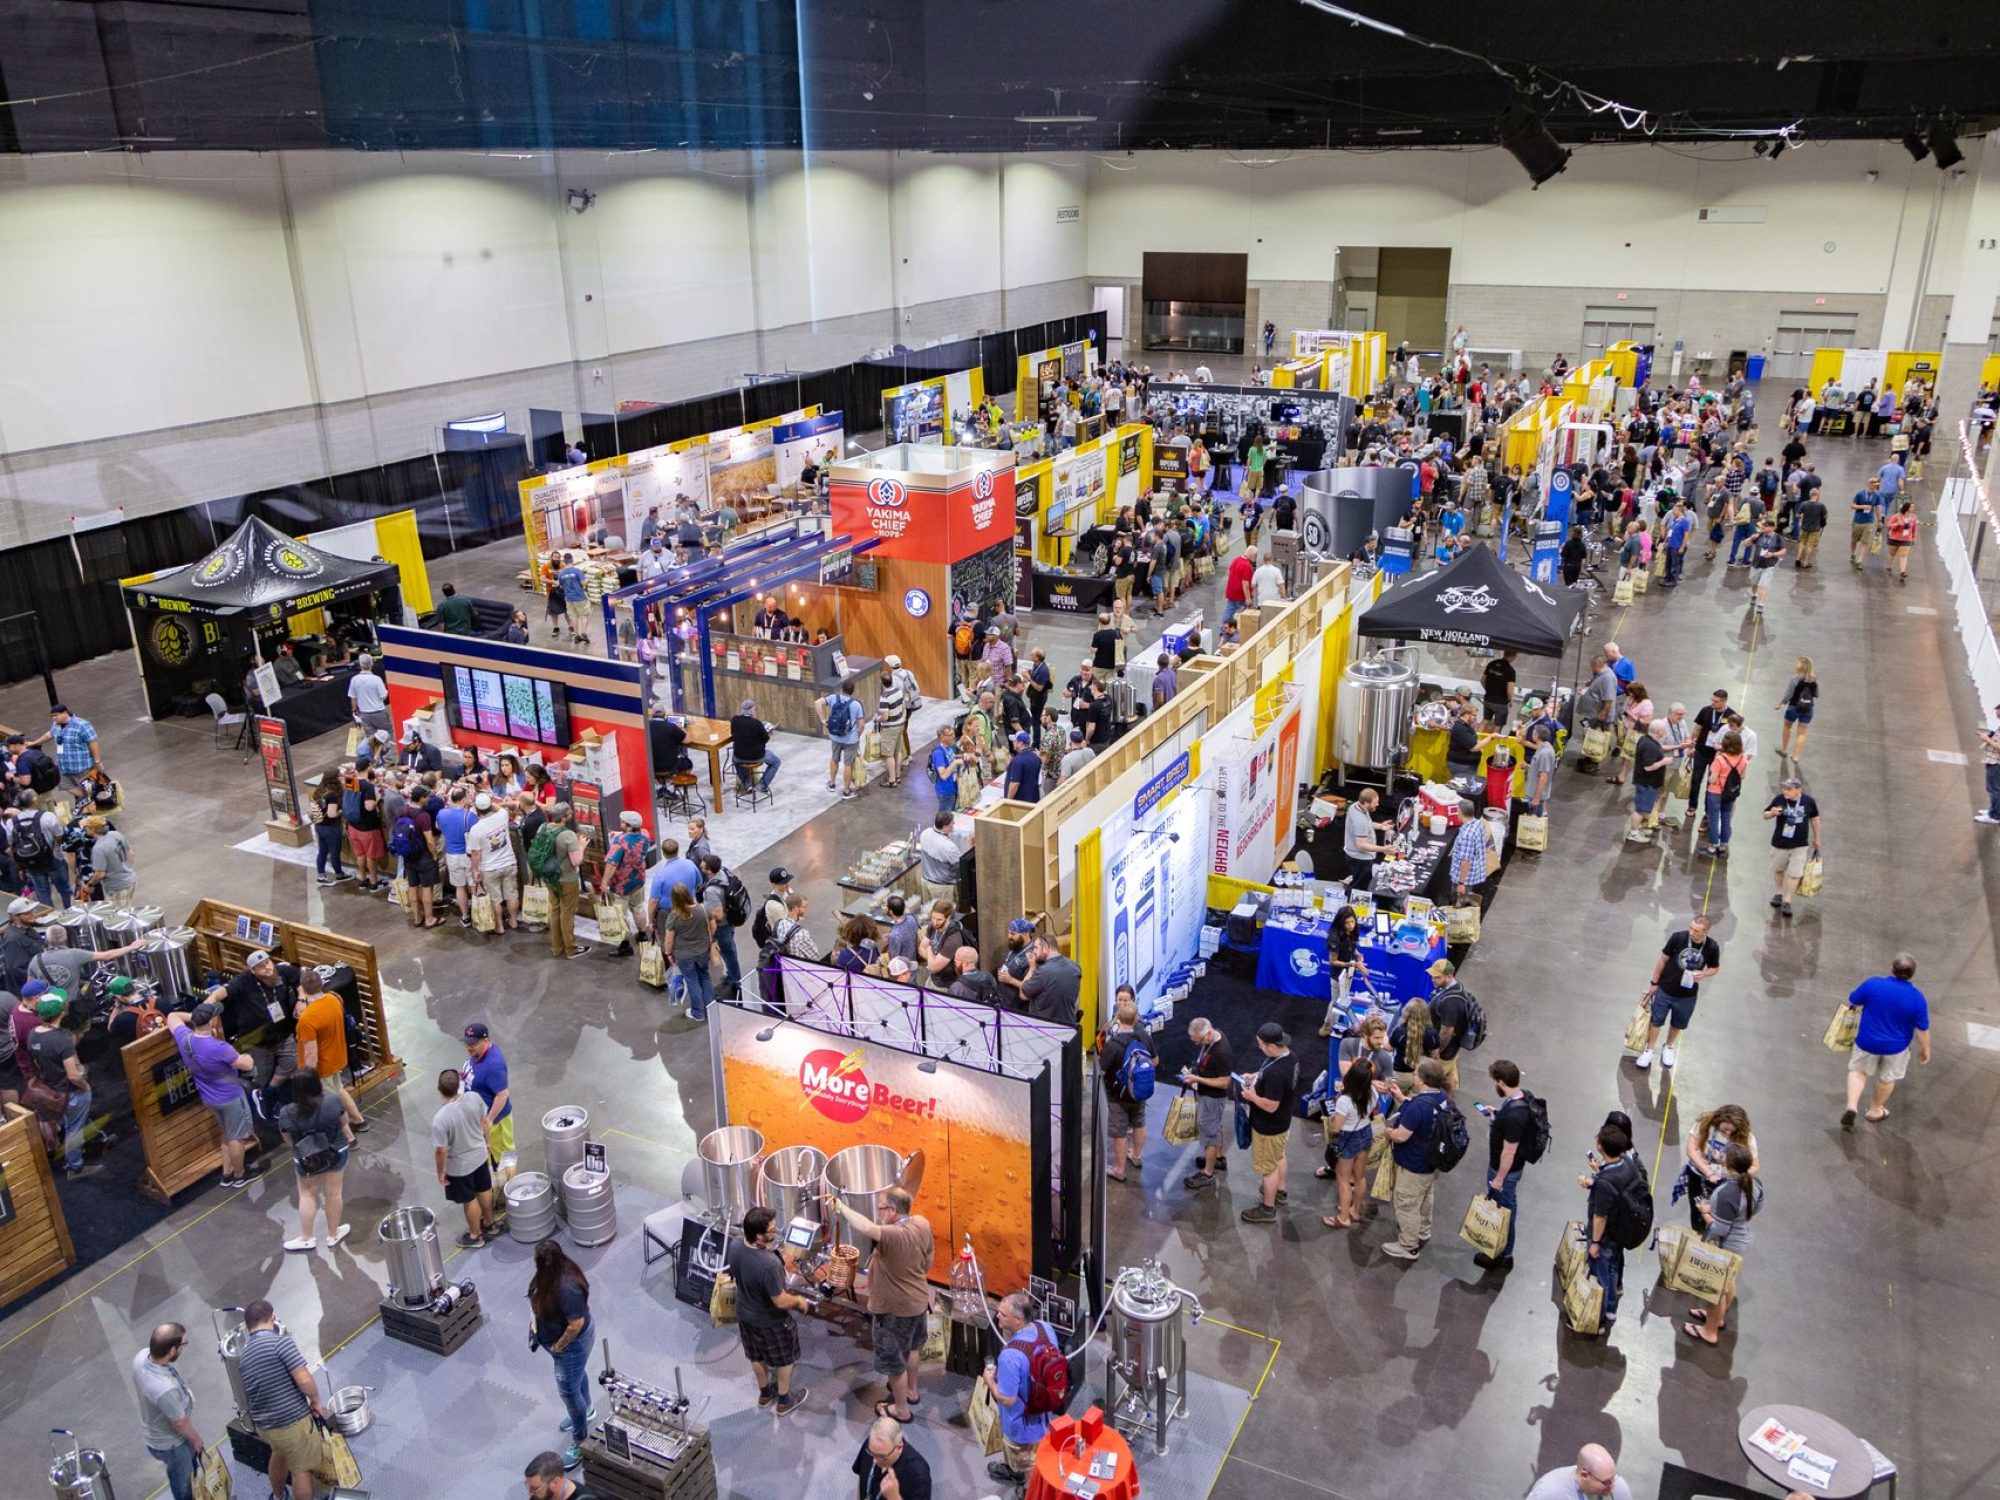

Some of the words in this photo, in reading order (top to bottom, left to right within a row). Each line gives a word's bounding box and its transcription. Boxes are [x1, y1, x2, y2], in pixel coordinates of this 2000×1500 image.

[1978, 238, 1997, 250] 13
[866, 507, 911, 522] YAKIMA
[971, 497, 996, 515] YAKIMA
[871, 518, 906, 532] CHIEF
[973, 508, 993, 525] CHIEF
[878, 529, 901, 538] HOPS
[158, 598, 192, 614] BREWING
[296, 587, 336, 610] BREWING
[1050, 595, 1079, 607] IMPERIAL
[1420, 628, 1442, 641] NEW
[1444, 630, 1490, 646] HOLLAND
[1138, 777, 1166, 807] SMART
[1166, 757, 1188, 784] BREW
[1218, 803, 1228, 812] TO
[1217, 813, 1227, 828] THE
[1111, 854, 1129, 881] SMART
[802, 1062, 870, 1102] More
[873, 1083, 937, 1120] Beer!
[1474, 1211, 1499, 1232] BRIESS
[1689, 1256, 1726, 1276] BRIESS
